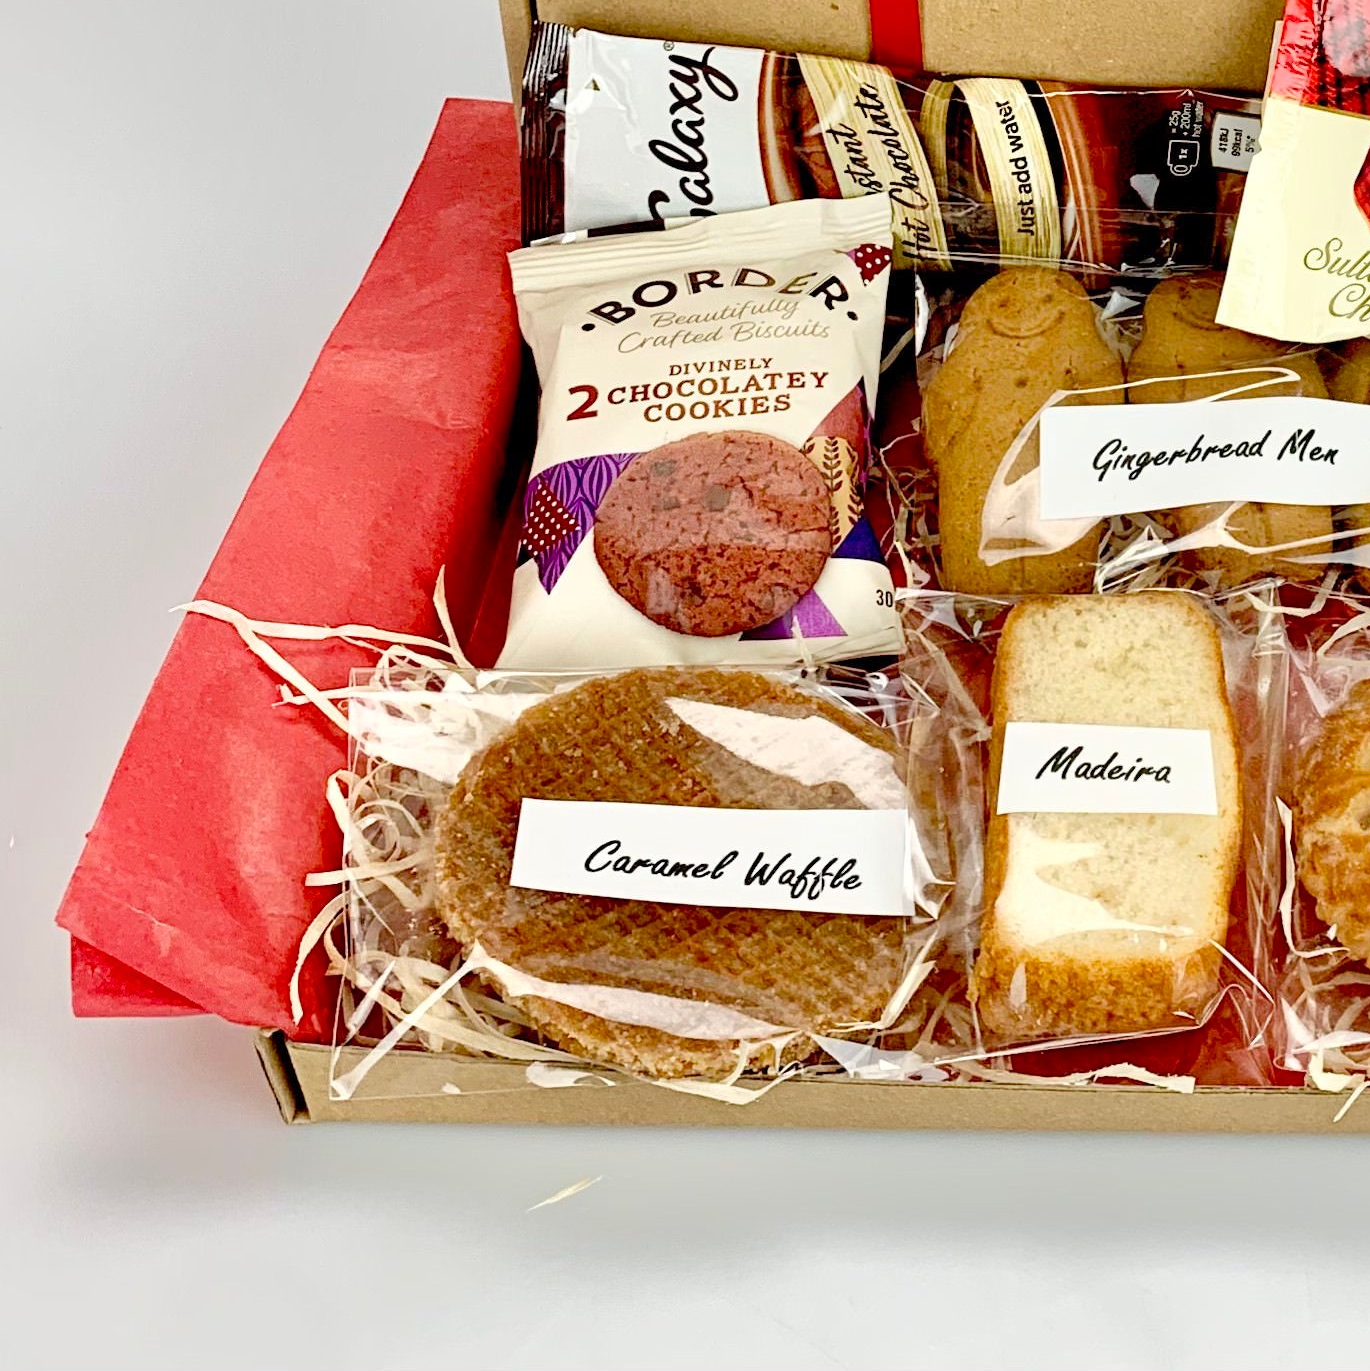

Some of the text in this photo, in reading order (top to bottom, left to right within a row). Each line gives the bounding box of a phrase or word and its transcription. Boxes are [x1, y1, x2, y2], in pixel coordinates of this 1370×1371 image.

[826, 123, 884, 197] stant
[854, 82, 938, 261] Hot Chocolate
[995, 100, 1036, 236] Just add water
[589, 268, 850, 326] BORDER
[650, 297, 801, 329] Beautifully
[617, 320, 831, 354] Crafted Biscuits
[668, 357, 773, 377] DIVINELY
[566, 370, 830, 421] 2 CHOCOLATEY
[643, 392, 792, 423] COOKIES
[1092, 427, 1340, 484] Gingerbread Men
[1035, 745, 1171, 784] Madeira
[584, 839, 863, 901] Caramel Waffle
